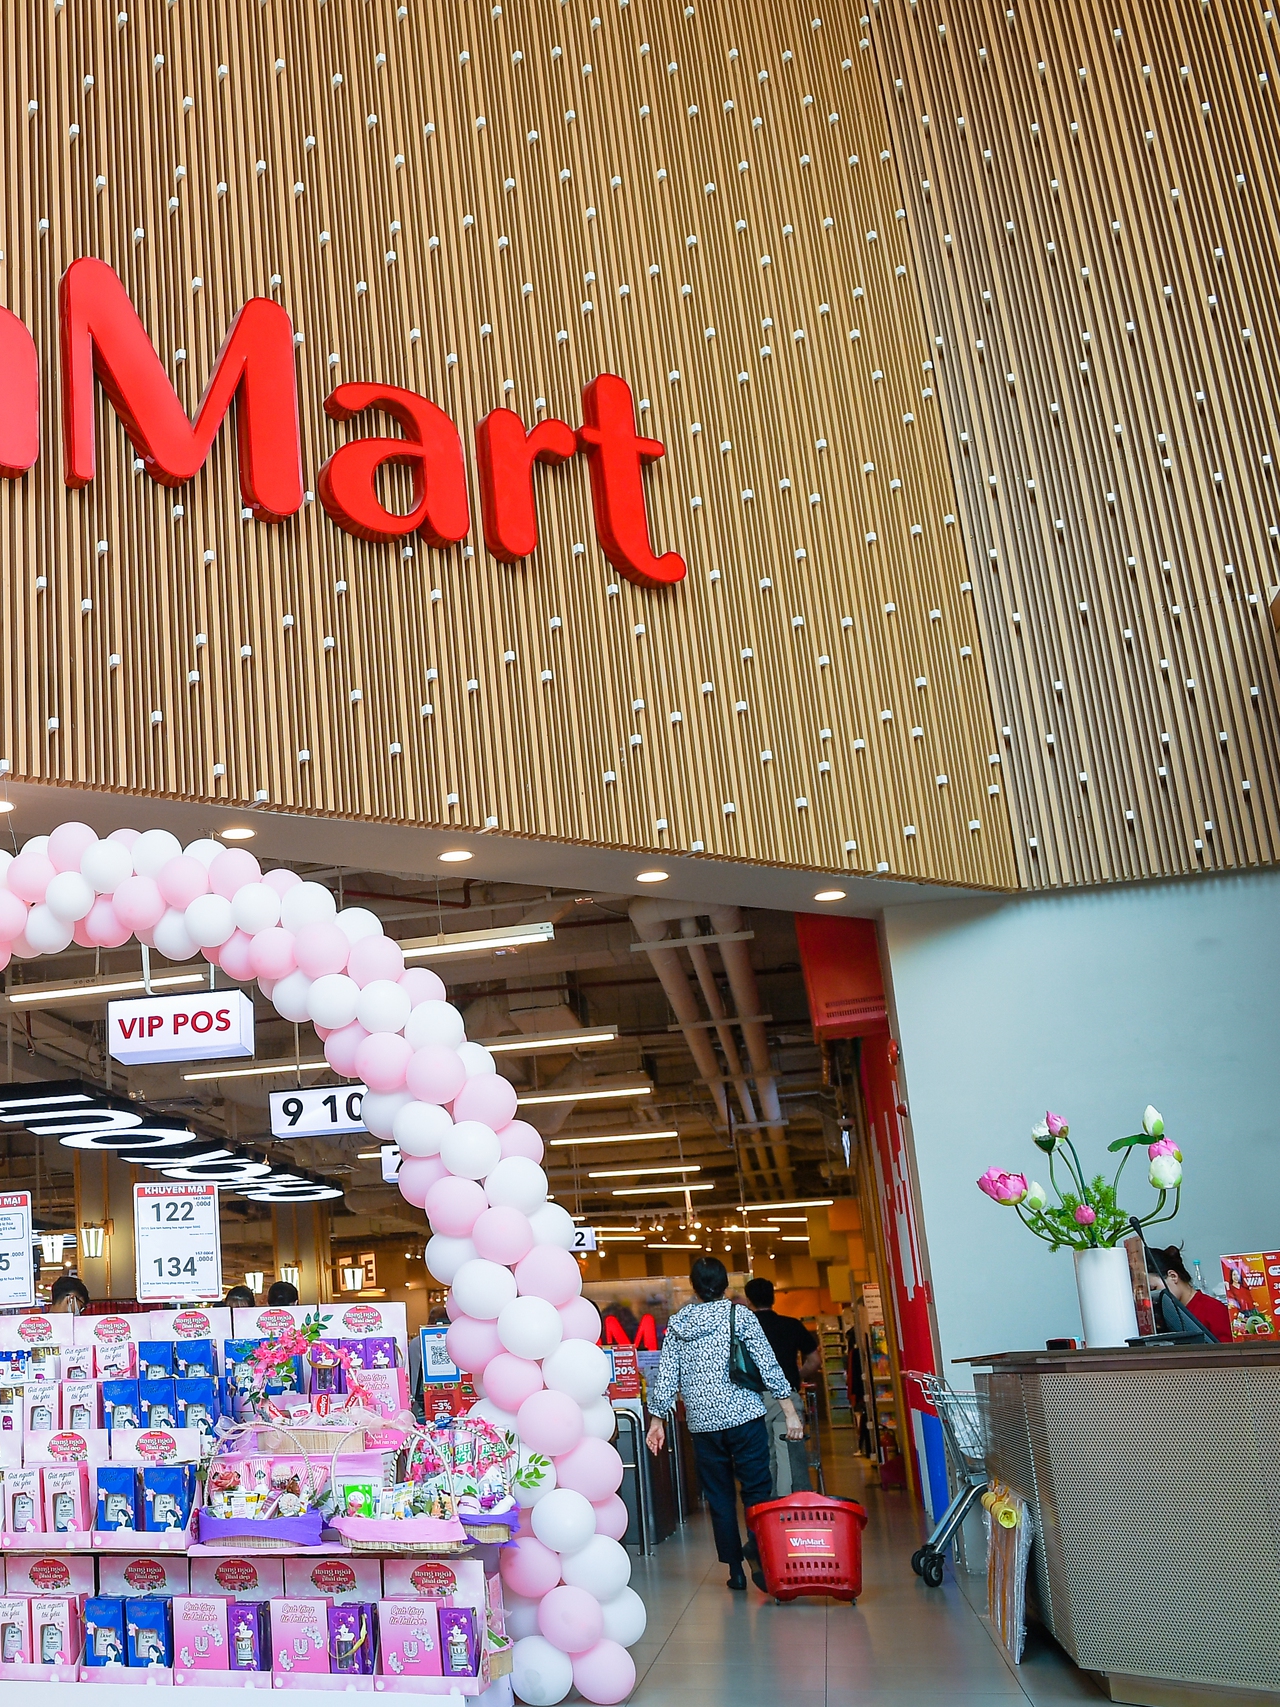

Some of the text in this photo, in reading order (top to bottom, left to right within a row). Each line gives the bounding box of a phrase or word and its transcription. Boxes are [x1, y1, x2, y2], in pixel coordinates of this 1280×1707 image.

[118, 1009, 231, 1040] VIP POS
[282, 1092, 363, 1127] 9 10
[4, 1196, 21, 1207] MẠI
[151, 1201, 195, 1222] 122
[153, 1256, 198, 1277] 134
[614, 1366, 636, 1375] 20%
[789, 1537, 825, 1547] WinMart
